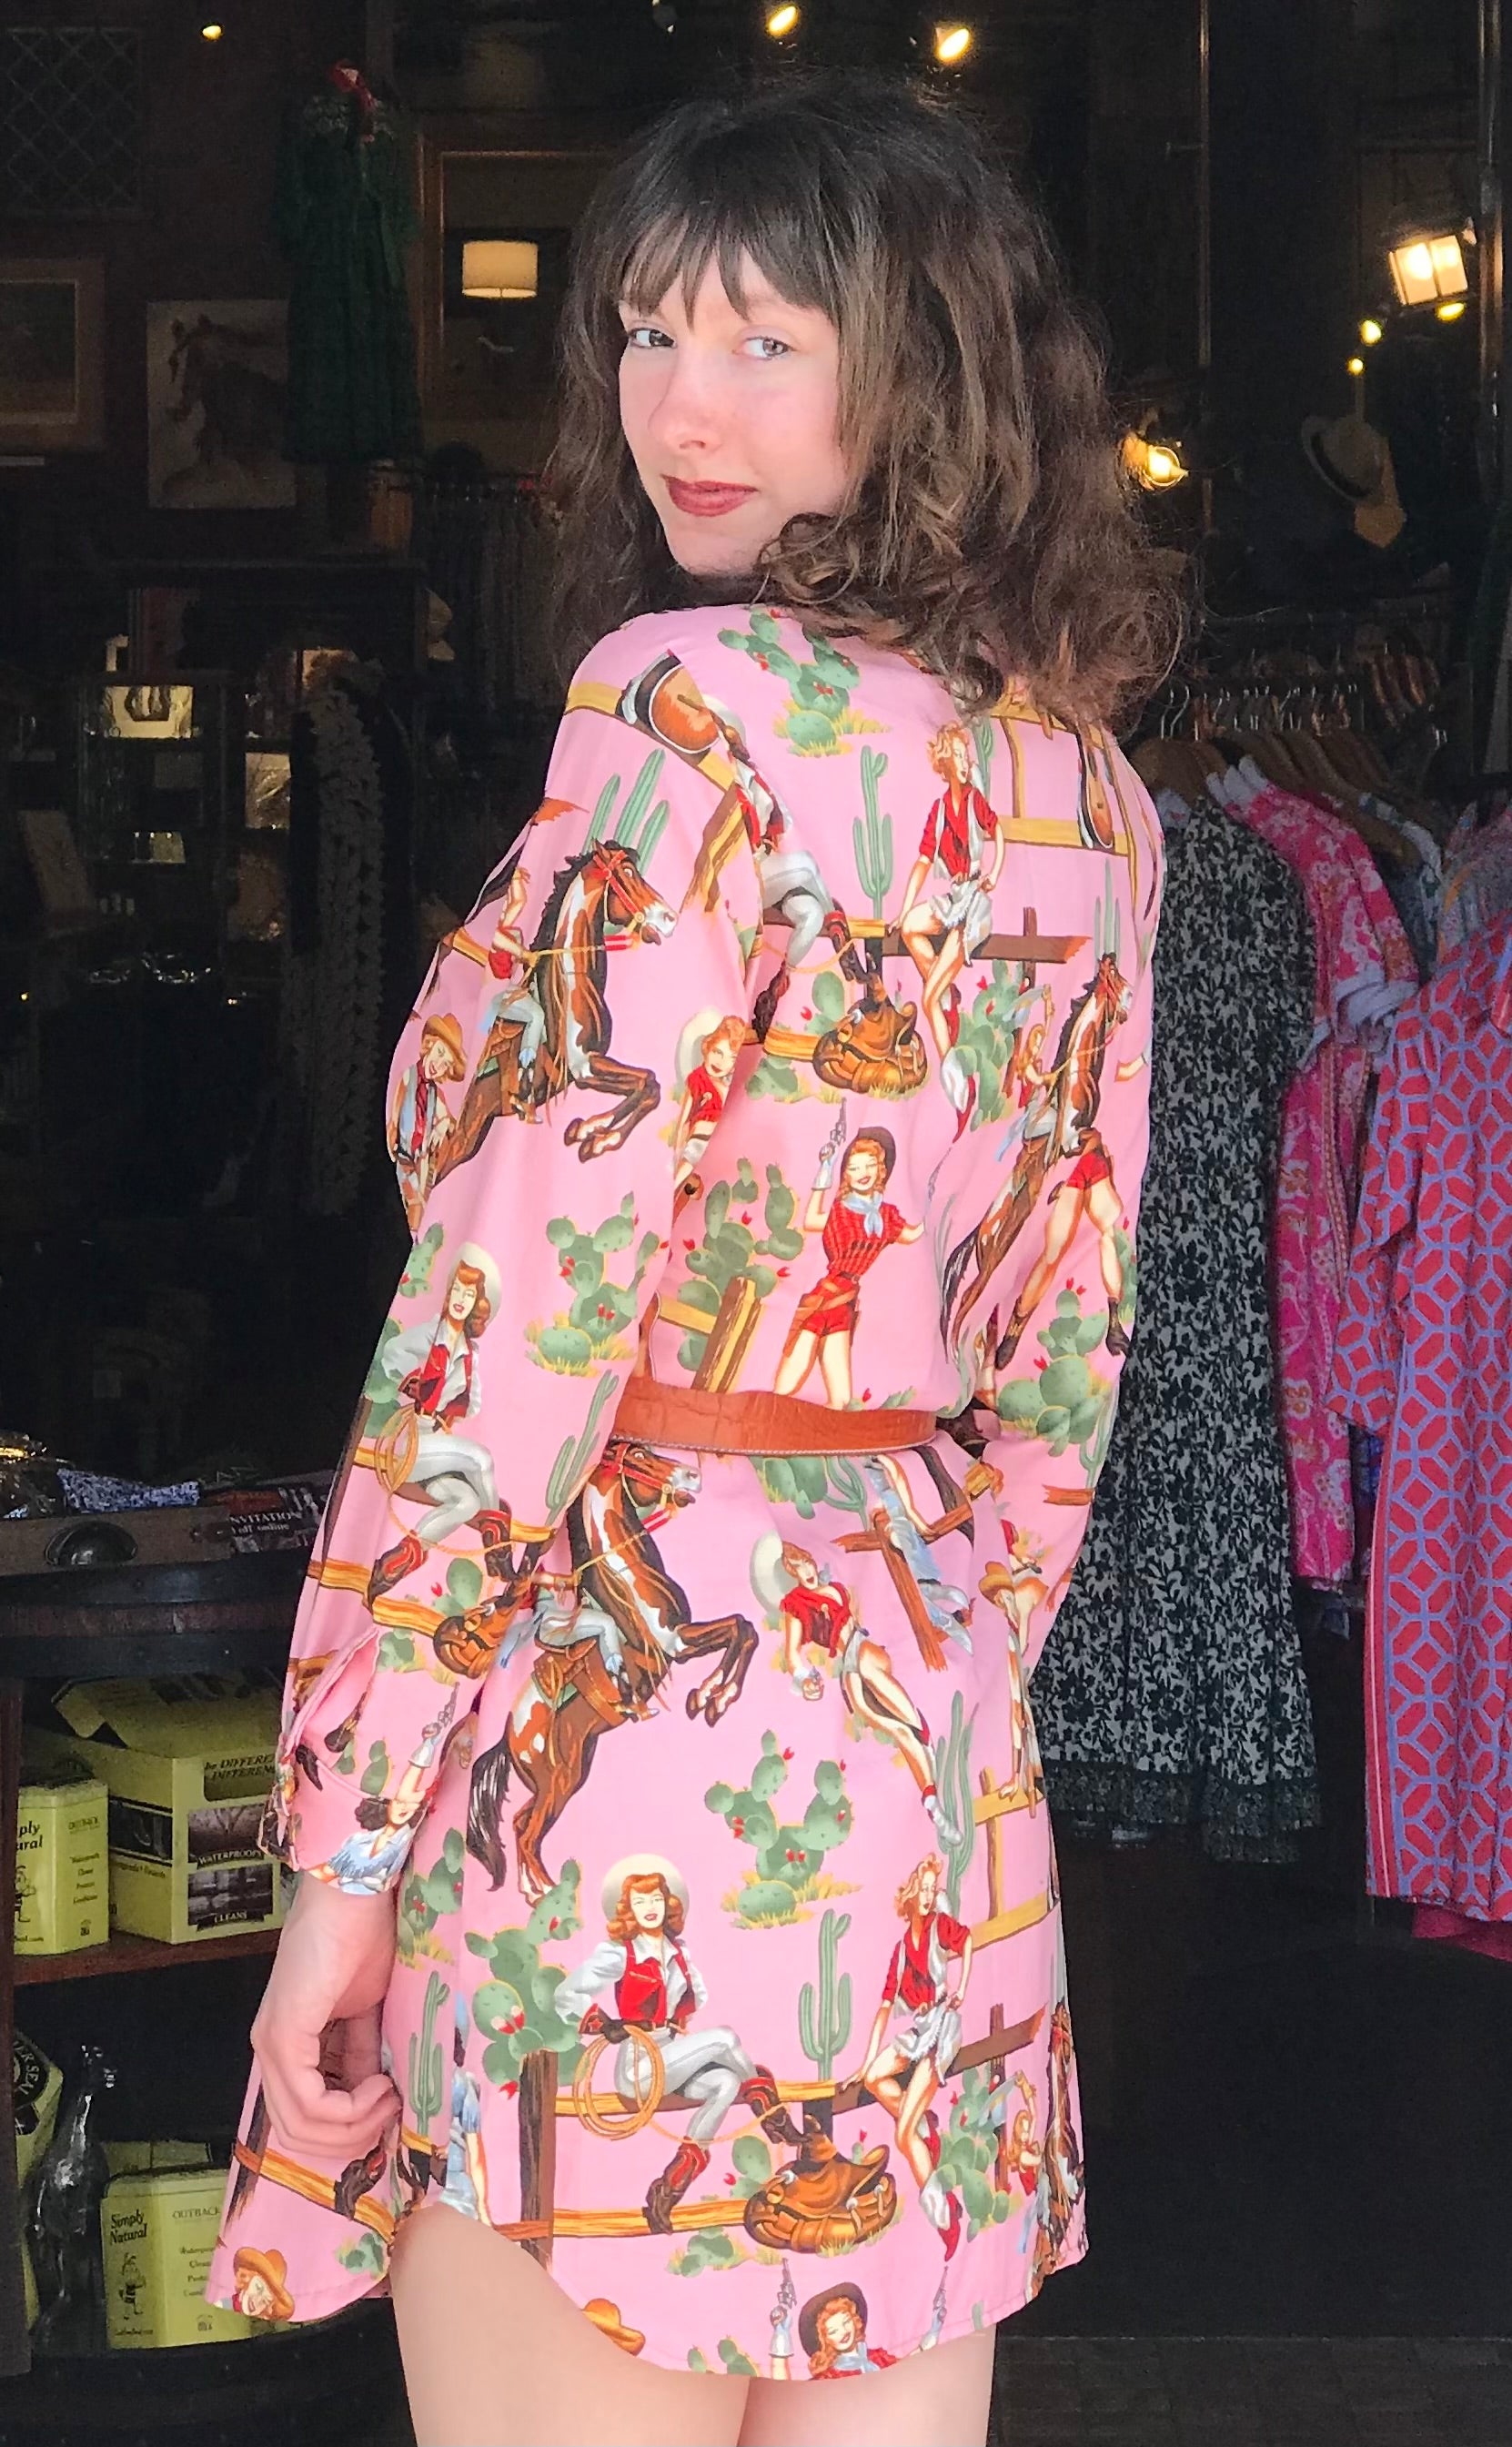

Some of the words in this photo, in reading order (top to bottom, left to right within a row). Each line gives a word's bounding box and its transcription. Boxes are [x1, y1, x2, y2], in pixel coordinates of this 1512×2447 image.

[229, 1512, 302, 1523] NVITATION
[220, 1754, 275, 1769] DIFFERE
[212, 1765, 276, 1780] DIFFEREN
[111, 2209, 145, 2230] Simply
[110, 2223, 147, 2245] Natural
